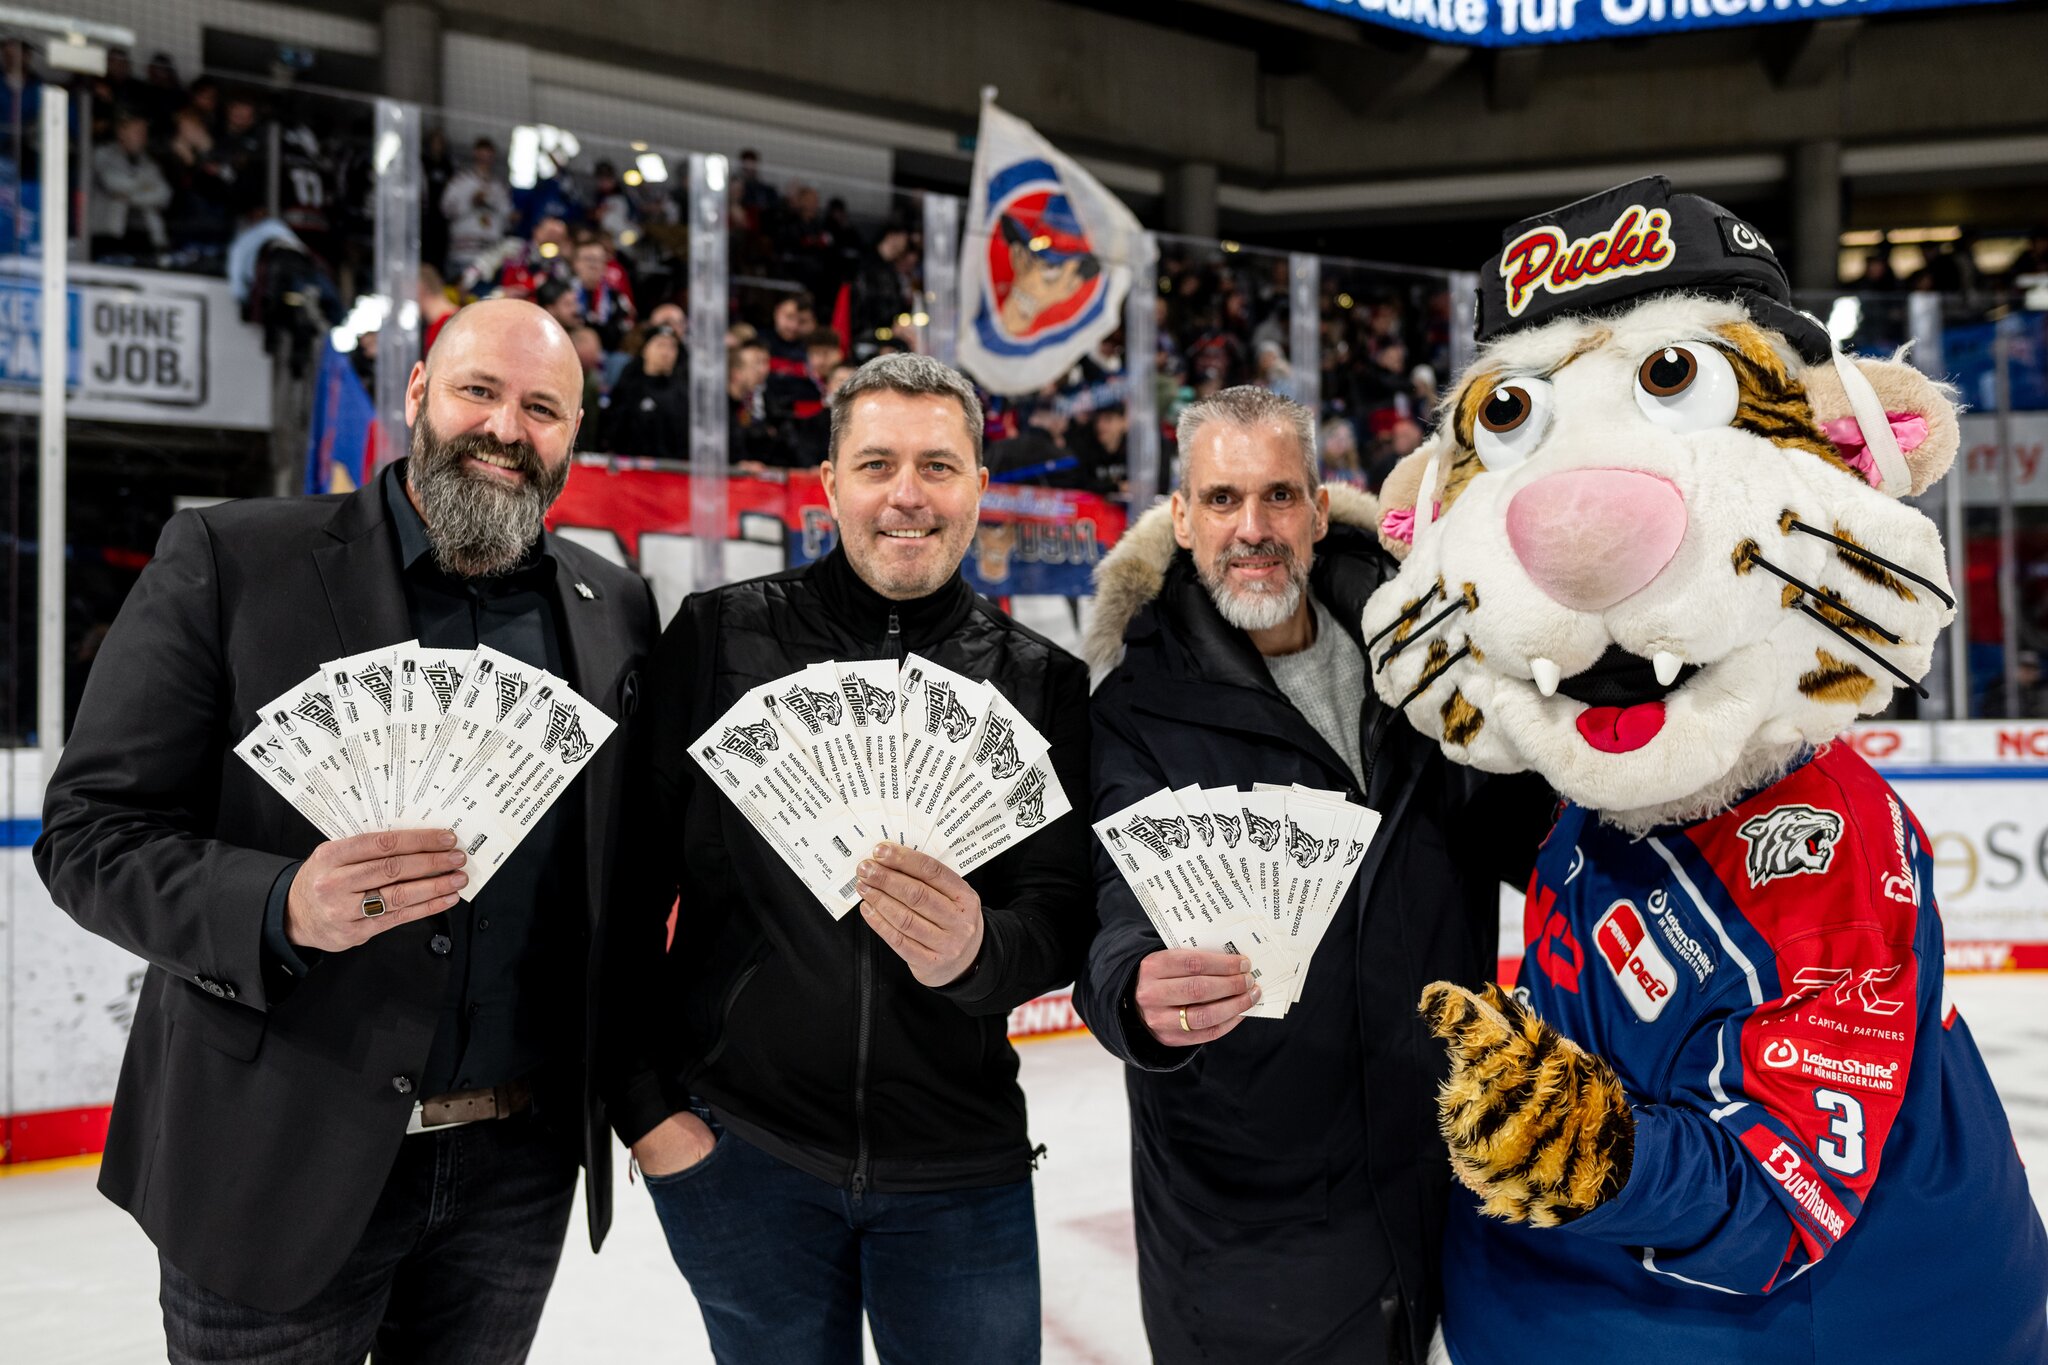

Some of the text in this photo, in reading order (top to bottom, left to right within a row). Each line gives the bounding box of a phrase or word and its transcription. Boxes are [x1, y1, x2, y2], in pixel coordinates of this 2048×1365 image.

[1501, 208, 1673, 313] Pucki
[93, 301, 183, 343] OHNE
[785, 693, 821, 734] ICETIGERS
[841, 682, 866, 726] ICETIGERS
[928, 685, 947, 734] ICETIGERS
[543, 705, 572, 752] ICETIGERS
[722, 733, 766, 766] ICETIGERS
[975, 716, 1007, 765] ICETIGERS
[494, 752, 535, 798] Straubing Tigers
[520, 760, 546, 787] Nürnberg
[787, 752, 832, 804] SAISON 2022/2023
[824, 741, 837, 772] Nürnberg
[845, 733, 871, 796] SAISON 2022/2023
[889, 735, 899, 800] SAISON 2022/2023
[915, 745, 935, 774] Nürnberg
[499, 796, 517, 814] Tigers
[520, 774, 565, 826] SAISON 2022/2023
[763, 775, 802, 820] Straubing Tigers
[773, 767, 796, 794] Nürnberg
[802, 800, 818, 820] Tigers
[925, 754, 957, 815] SAISON 2022/2023
[949, 772, 976, 797] Nürnberg
[1006, 766, 1040, 808] ICETIGERS
[943, 789, 993, 838] SAISON 2022/2023
[958, 833, 1011, 869] SAISON 2022/2023
[1127, 822, 1171, 859] ICETIGERS
[1196, 854, 1234, 910] SAISON 2022/2023
[1218, 853, 1235, 879] SAISON
[1164, 869, 1195, 920] Straubing Tigers
[1176, 864, 1195, 894] Nürnberg
[1200, 903, 1213, 923] Tigers
[1291, 879, 1311, 936] SAISON 2022/2023
[1657, 916, 1666, 929] IM
[1808, 1015, 1849, 1033] CAPITAL
[1852, 1026, 1905, 1042] PARTNERS
[1801, 1063, 1811, 1075] IM
[1812, 1086, 1867, 1178] 3
[1761, 1141, 1845, 1240] Buchhauser
